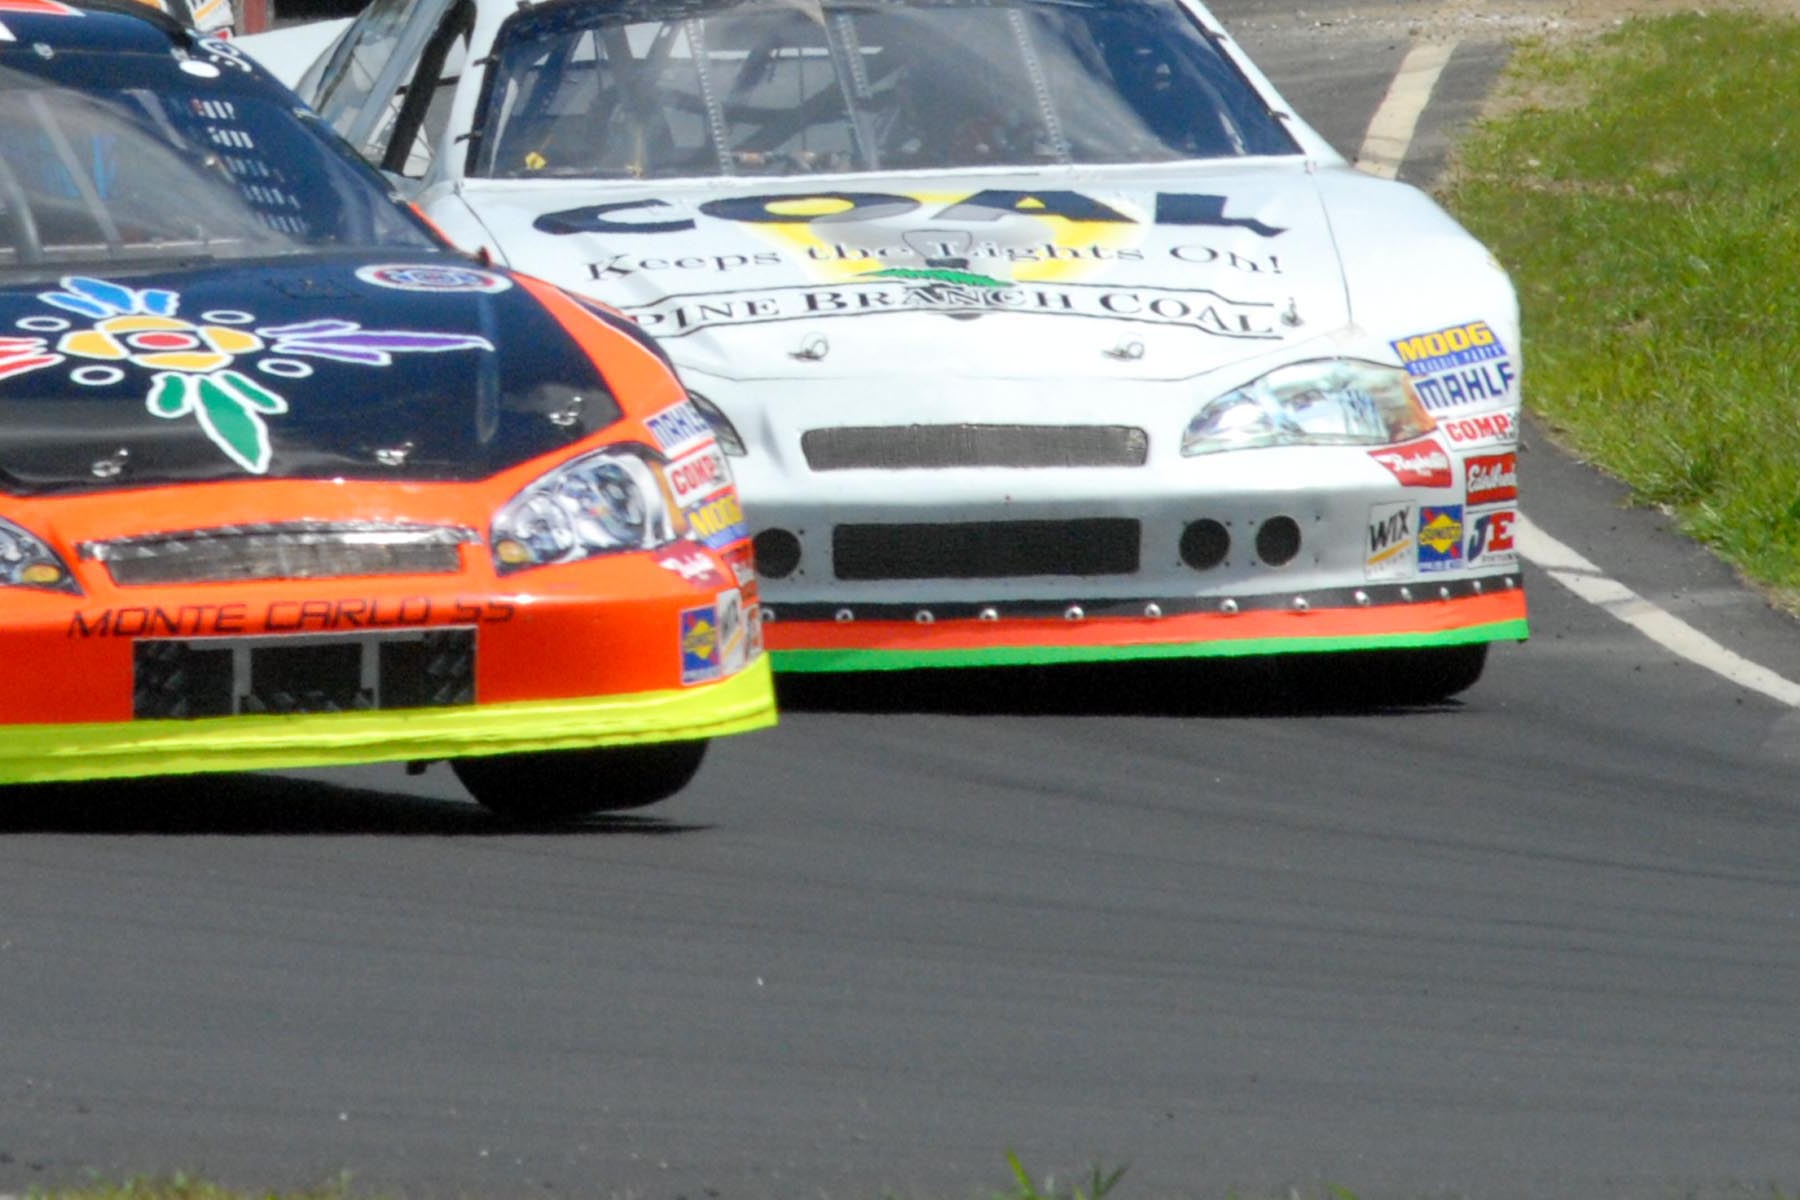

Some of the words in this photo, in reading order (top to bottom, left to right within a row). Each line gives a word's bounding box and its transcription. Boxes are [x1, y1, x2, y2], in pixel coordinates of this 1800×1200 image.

[532, 188, 1289, 238] COAL
[586, 251, 782, 282] Keeps
[807, 244, 910, 260] the
[926, 241, 1145, 263] Lights
[1169, 244, 1284, 275] On!
[804, 286, 1075, 312] BRANCH
[1099, 291, 1274, 334] COAL
[1396, 321, 1494, 363] MOOG
[1445, 414, 1509, 443] COMP
[1369, 506, 1411, 551] WIX
[1467, 511, 1515, 563] JE
[66, 603, 248, 638] MONTE
[264, 597, 432, 630] CARLO
[450, 599, 516, 624] SS
